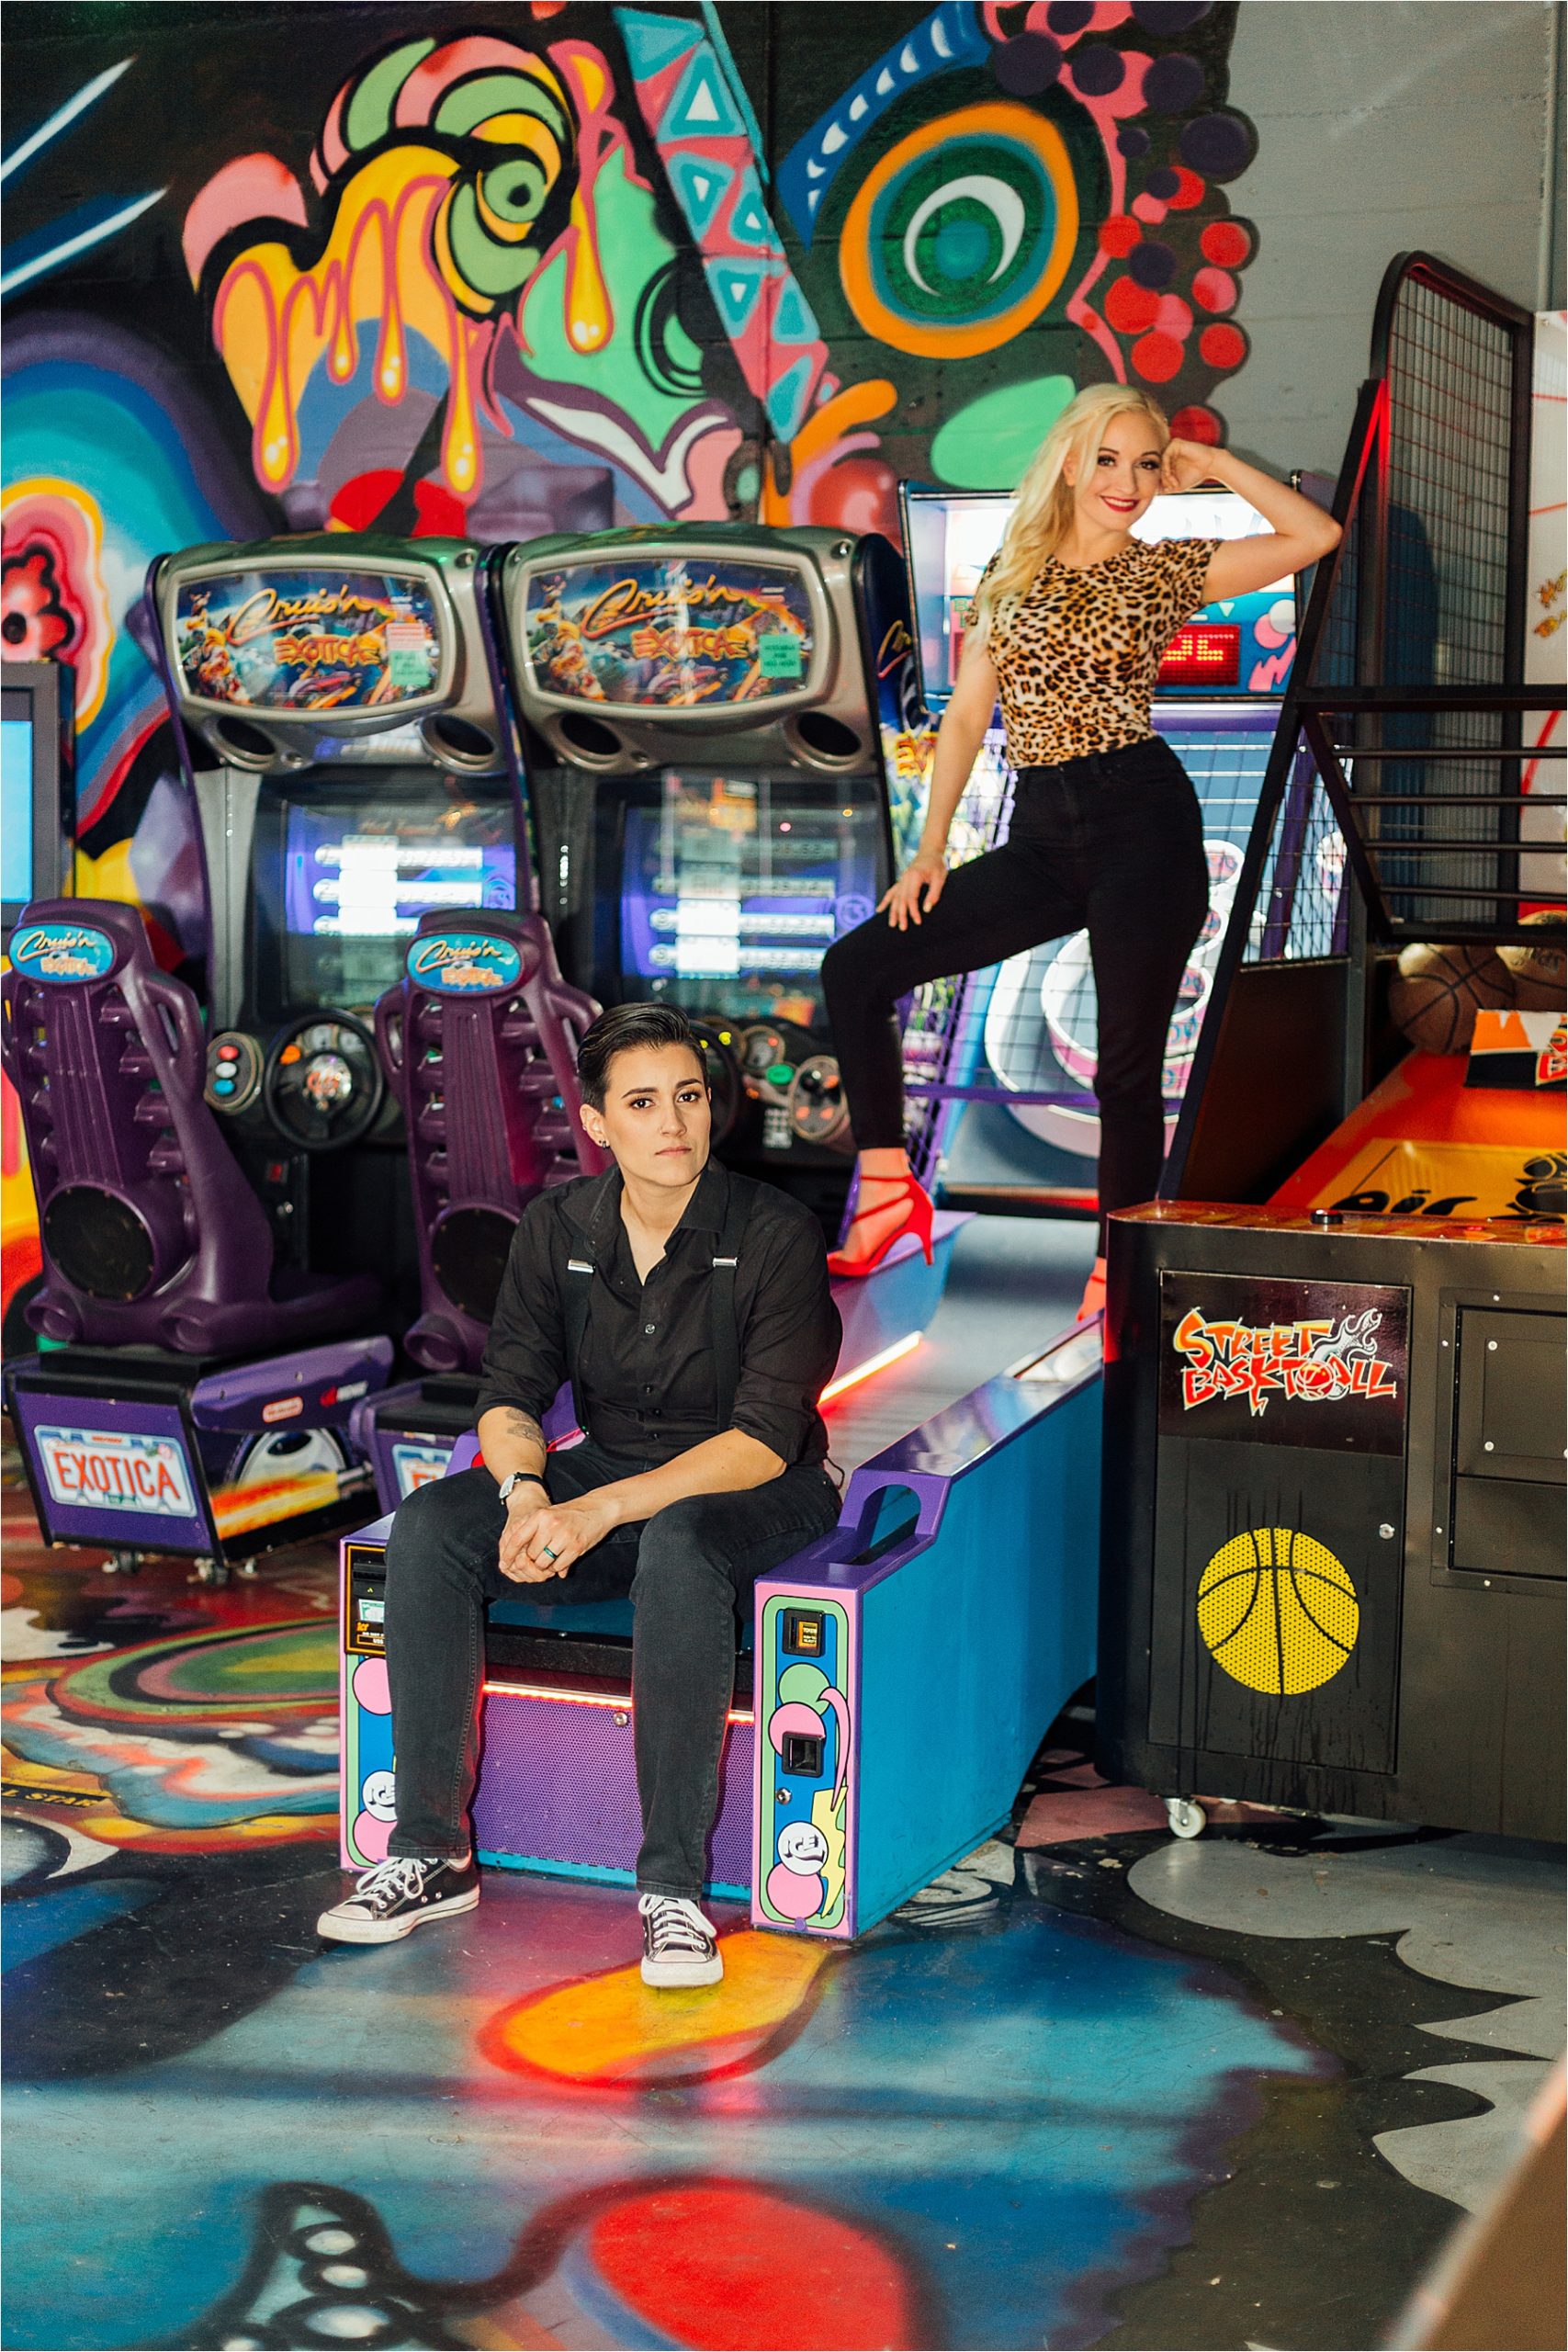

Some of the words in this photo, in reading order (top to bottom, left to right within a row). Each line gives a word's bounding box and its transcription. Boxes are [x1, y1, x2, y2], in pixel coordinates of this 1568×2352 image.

[226, 583, 381, 646] Cruis'n
[579, 573, 741, 639] Cruis'n
[273, 633, 379, 668] EXOTICA
[1173, 1306, 1336, 1369] STREET
[53, 1451, 181, 1500] EXOTICA
[784, 1834, 826, 1863] ICE
